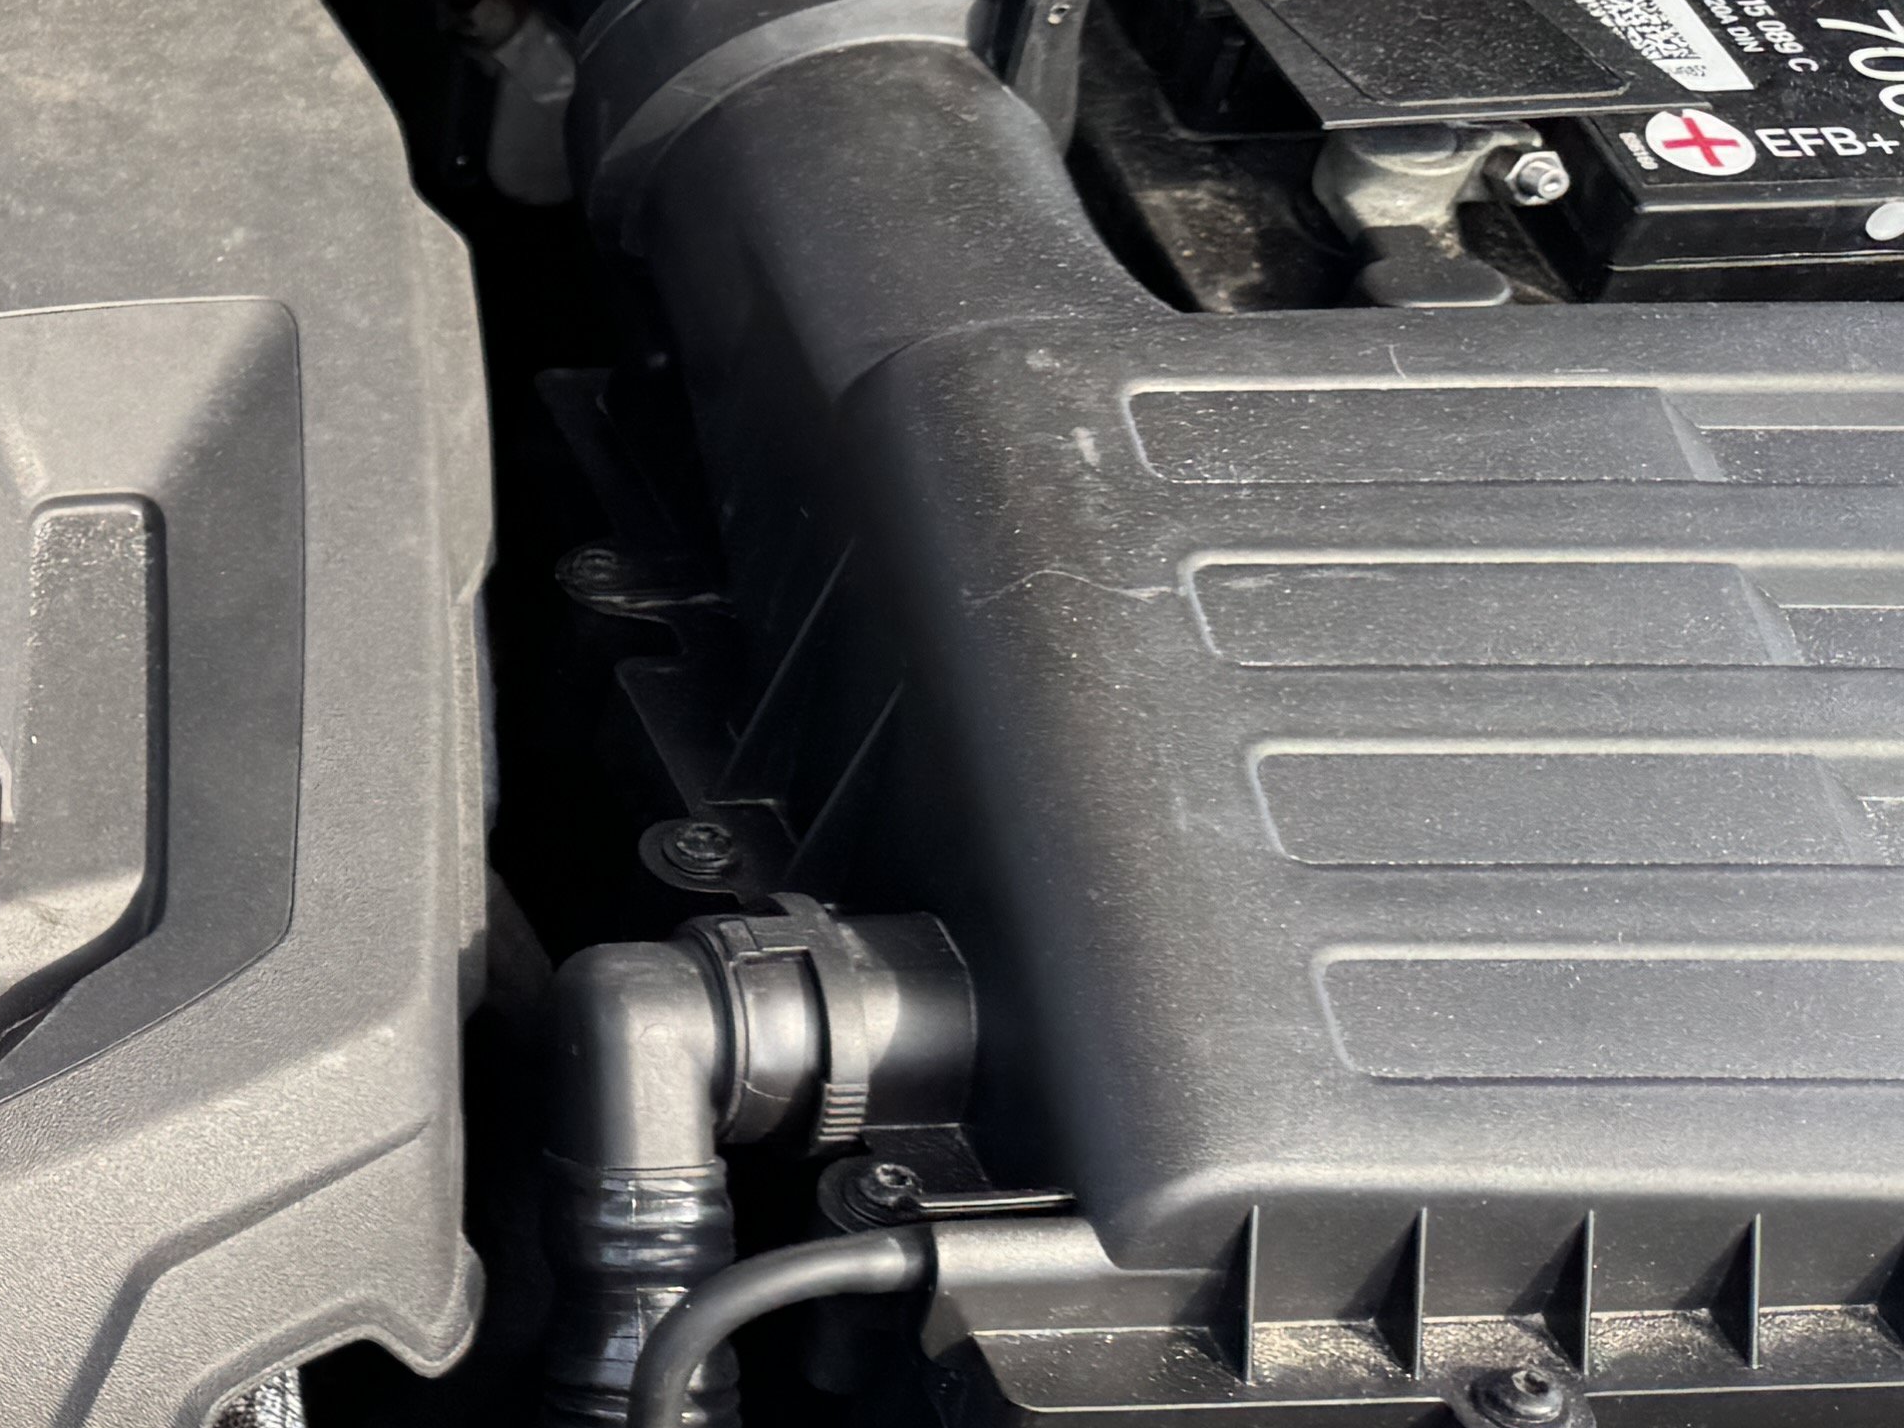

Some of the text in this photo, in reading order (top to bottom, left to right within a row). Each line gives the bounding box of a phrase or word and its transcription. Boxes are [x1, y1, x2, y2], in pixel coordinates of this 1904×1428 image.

[1726, 25, 1766, 54] DIN
[1756, 19, 1804, 55] 089
[1788, 57, 1820, 73] C
[1817, 9, 1904, 134] 70
[1754, 126, 1901, 158] EFB+
